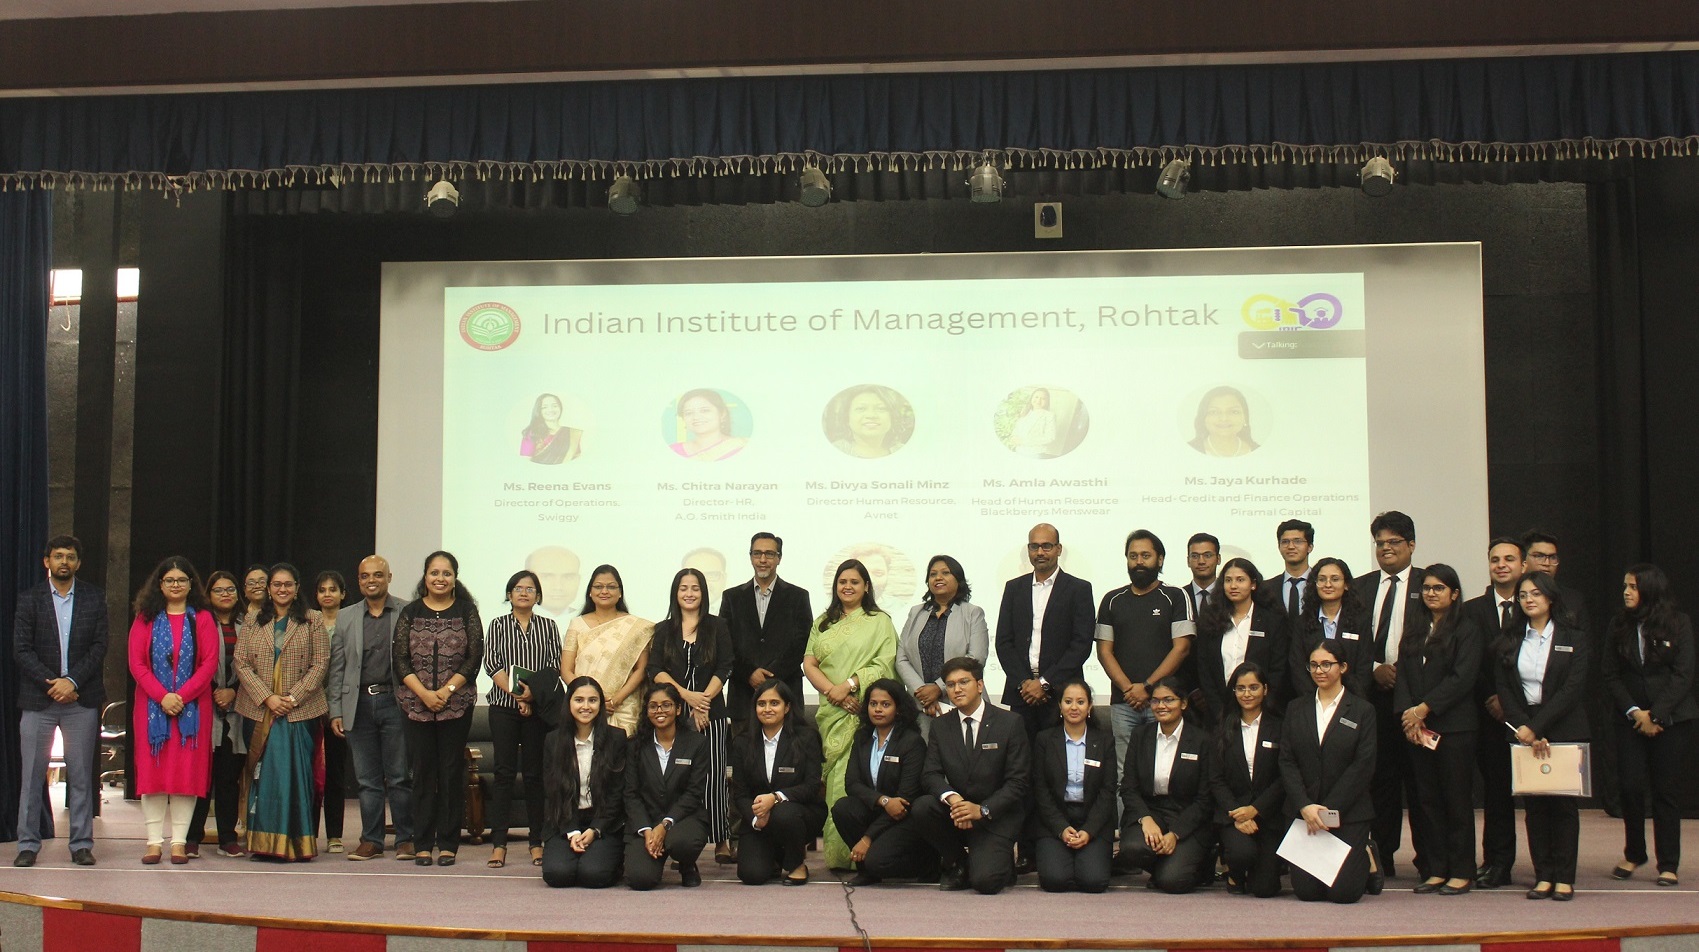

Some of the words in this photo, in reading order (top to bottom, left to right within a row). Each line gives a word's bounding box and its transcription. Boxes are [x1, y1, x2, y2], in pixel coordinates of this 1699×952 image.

[543, 311, 645, 335] Indian
[656, 310, 798, 333] Institute
[807, 308, 844, 332] of
[853, 307, 1087, 336] Management,
[1098, 302, 1220, 328] Rohtak
[1266, 341, 1298, 350] Talking:
[503, 482, 525, 491] Ms.
[527, 482, 570, 491] Reena
[572, 481, 612, 491] Evans
[805, 480, 828, 490] Ms.
[830, 480, 868, 492] Divya
[870, 479, 914, 490] Sonali
[916, 479, 950, 490] Minz
[982, 478, 1005, 488] Ms.
[1008, 477, 1046, 488] Amla
[1048, 476, 1109, 488] Awasthi
[1184, 476, 1208, 486] Ms.
[1209, 476, 1243, 487] Jaya
[1245, 475, 1308, 486] Kurhade
[656, 482, 678, 491] Ms.
[681, 480, 721, 491] Chitra
[724, 481, 779, 494] Narayan
[494, 499, 539, 508] Director
[541, 498, 554, 508] of
[806, 496, 854, 506] Director
[856, 496, 899, 506] Human
[971, 497, 1002, 506] Head
[1004, 496, 1017, 505] of
[1018, 496, 1061, 505] Human
[1064, 496, 1119, 505] Resource
[1218, 493, 1241, 502] and
[1243, 493, 1291, 502] Finance
[1292, 493, 1360, 503] Operations
[700, 511, 735, 521] Smith
[737, 511, 767, 521] India
[863, 511, 899, 520] Avnet
[980, 507, 1049, 517] Blackberrys
[1051, 507, 1112, 516] Menswear
[1230, 507, 1277, 517] Piramal
[1279, 507, 1322, 517] Capital
[537, 512, 580, 523] Swiggy
